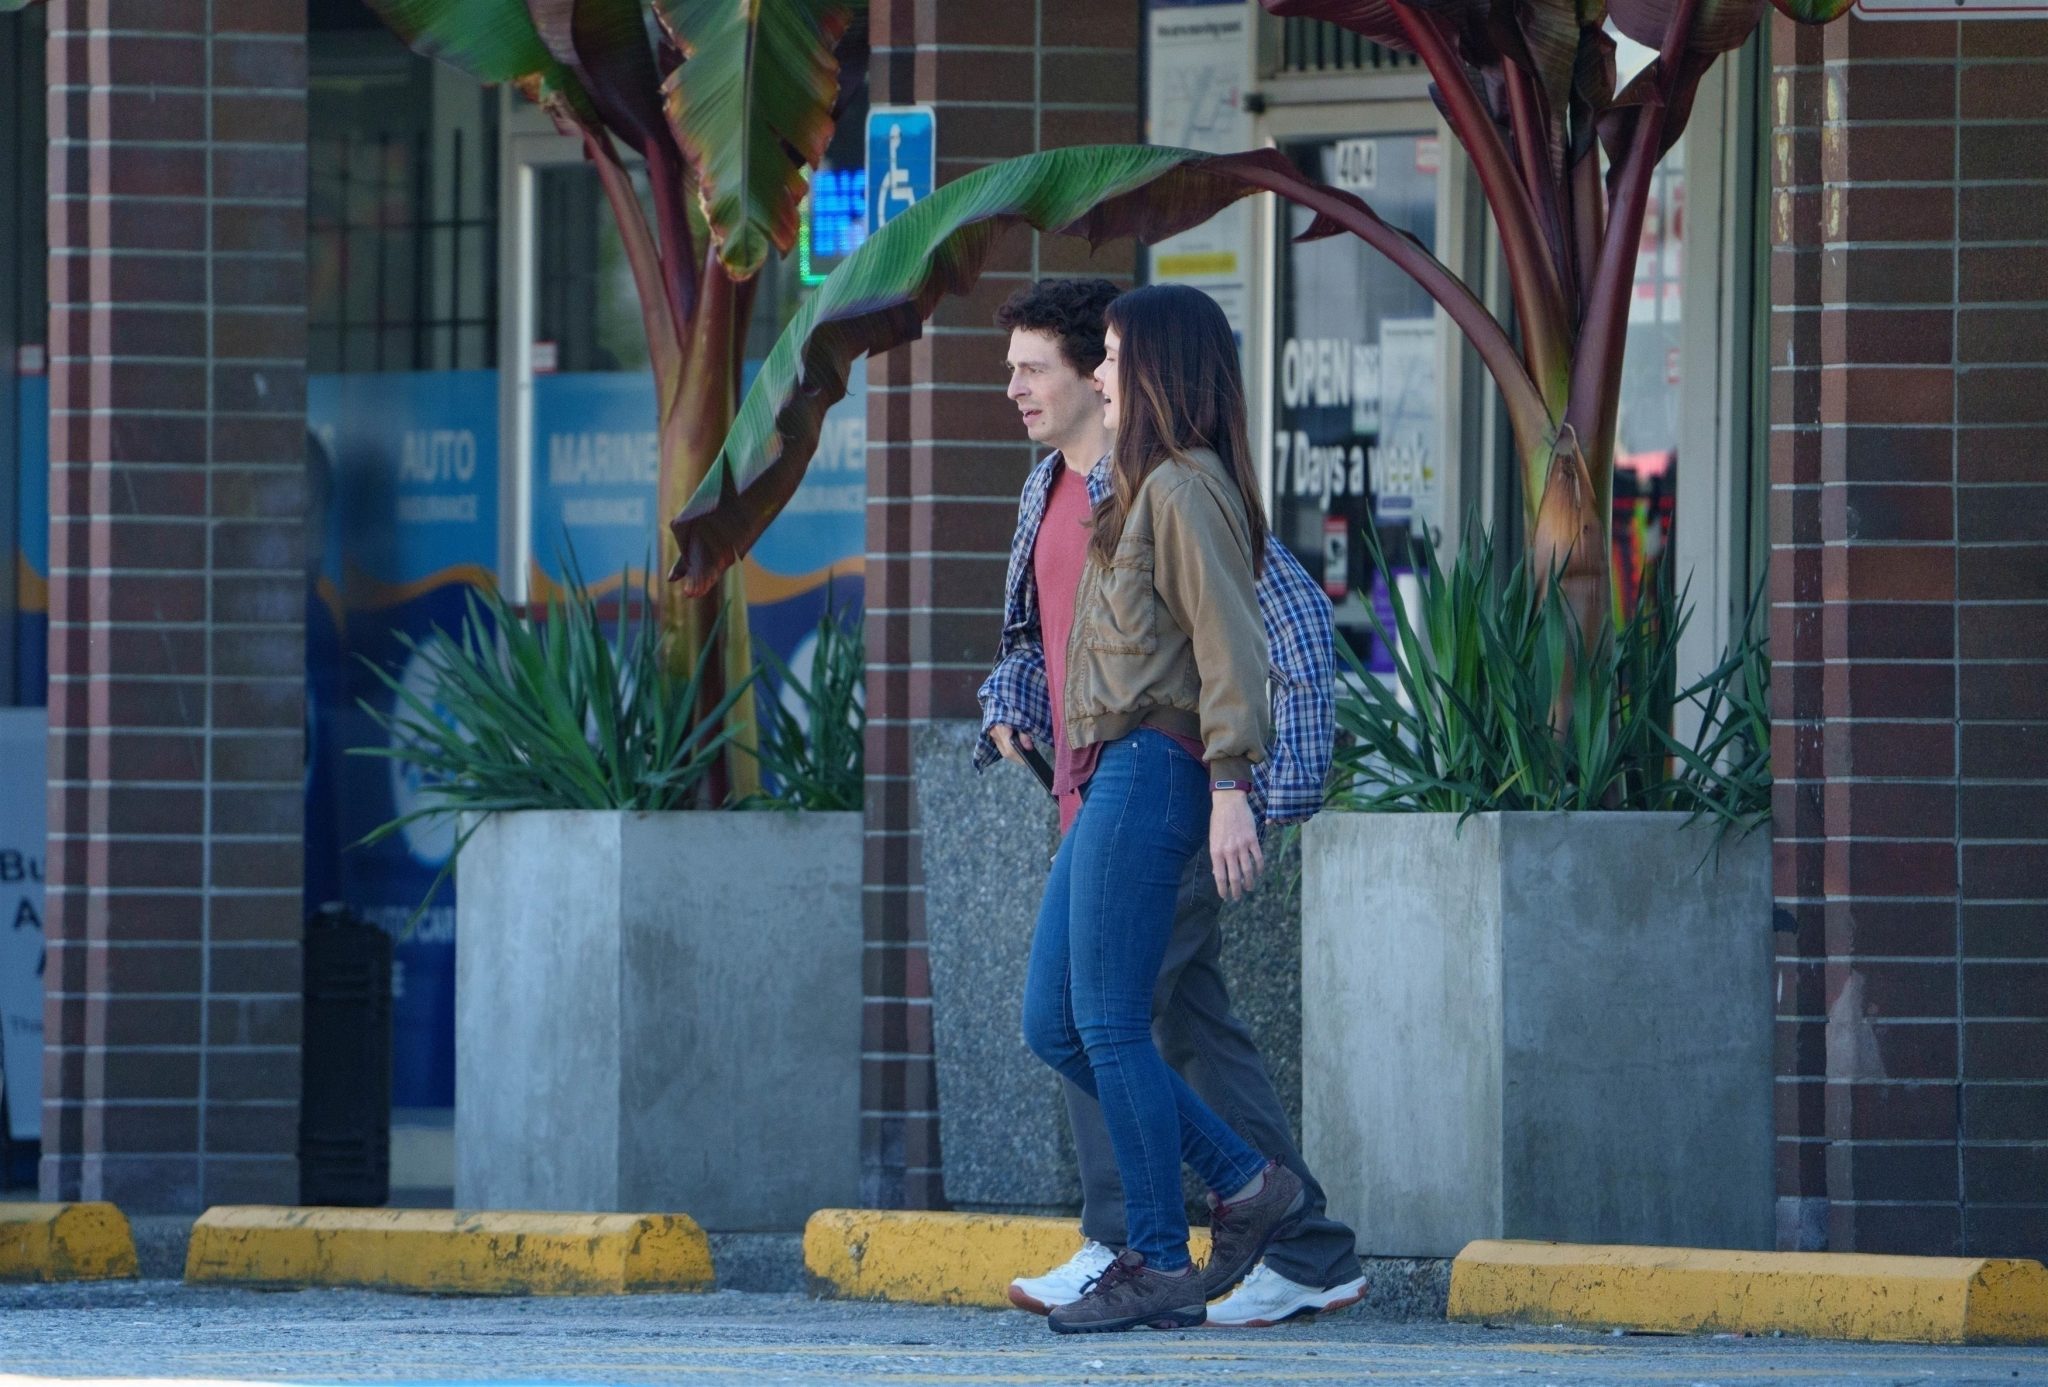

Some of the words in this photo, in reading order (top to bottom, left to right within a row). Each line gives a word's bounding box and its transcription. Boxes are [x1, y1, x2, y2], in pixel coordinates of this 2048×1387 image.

[1282, 338, 1350, 409] OPEN
[400, 429, 477, 482] AUTO
[550, 432, 659, 483] MARINE
[1275, 431, 1291, 496] 7
[1294, 431, 1345, 511] Days
[1350, 445, 1364, 496] a
[1367, 431, 1426, 496] week
[0, 849, 45, 882] Bu
[13, 897, 43, 930] A
